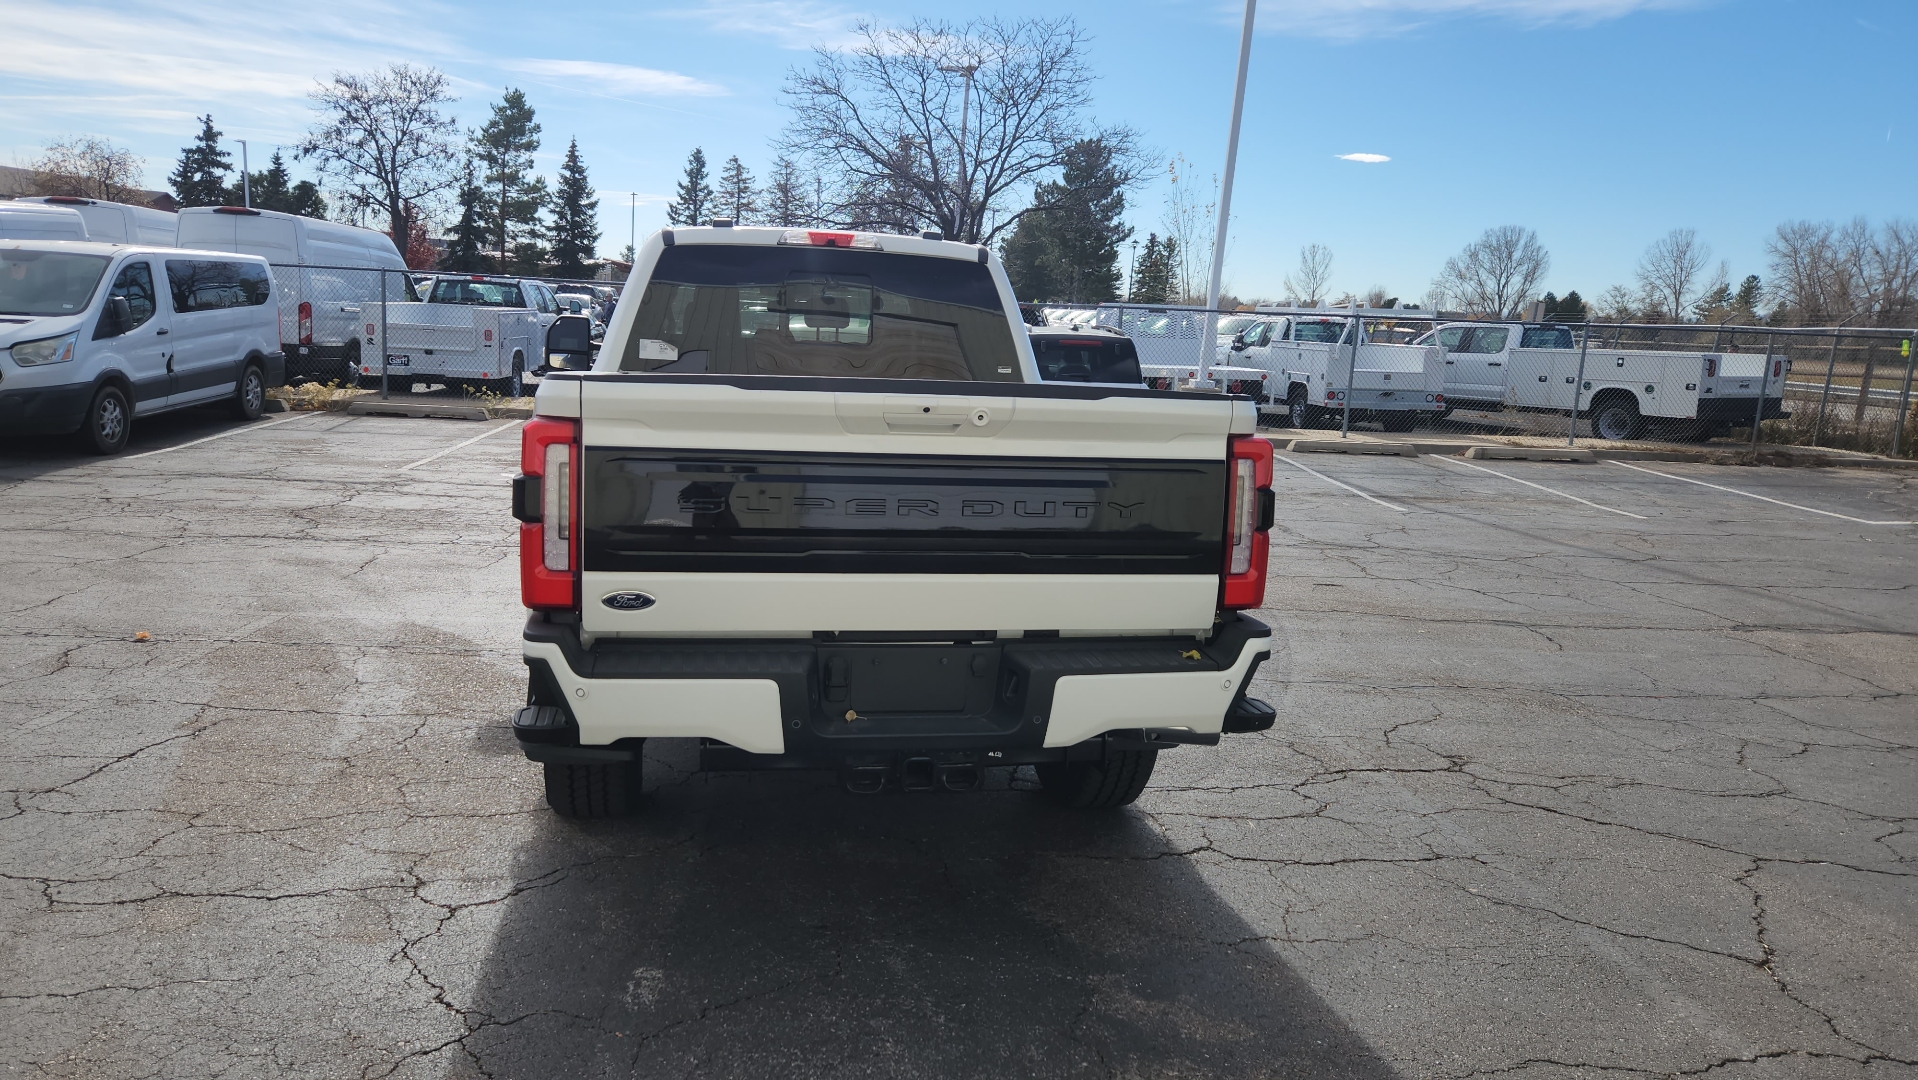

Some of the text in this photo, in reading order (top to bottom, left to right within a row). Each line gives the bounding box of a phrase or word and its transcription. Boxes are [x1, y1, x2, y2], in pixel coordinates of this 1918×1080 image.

[678, 496, 1146, 519] SUPER DUTY
[613, 594, 644, 607] Ford
